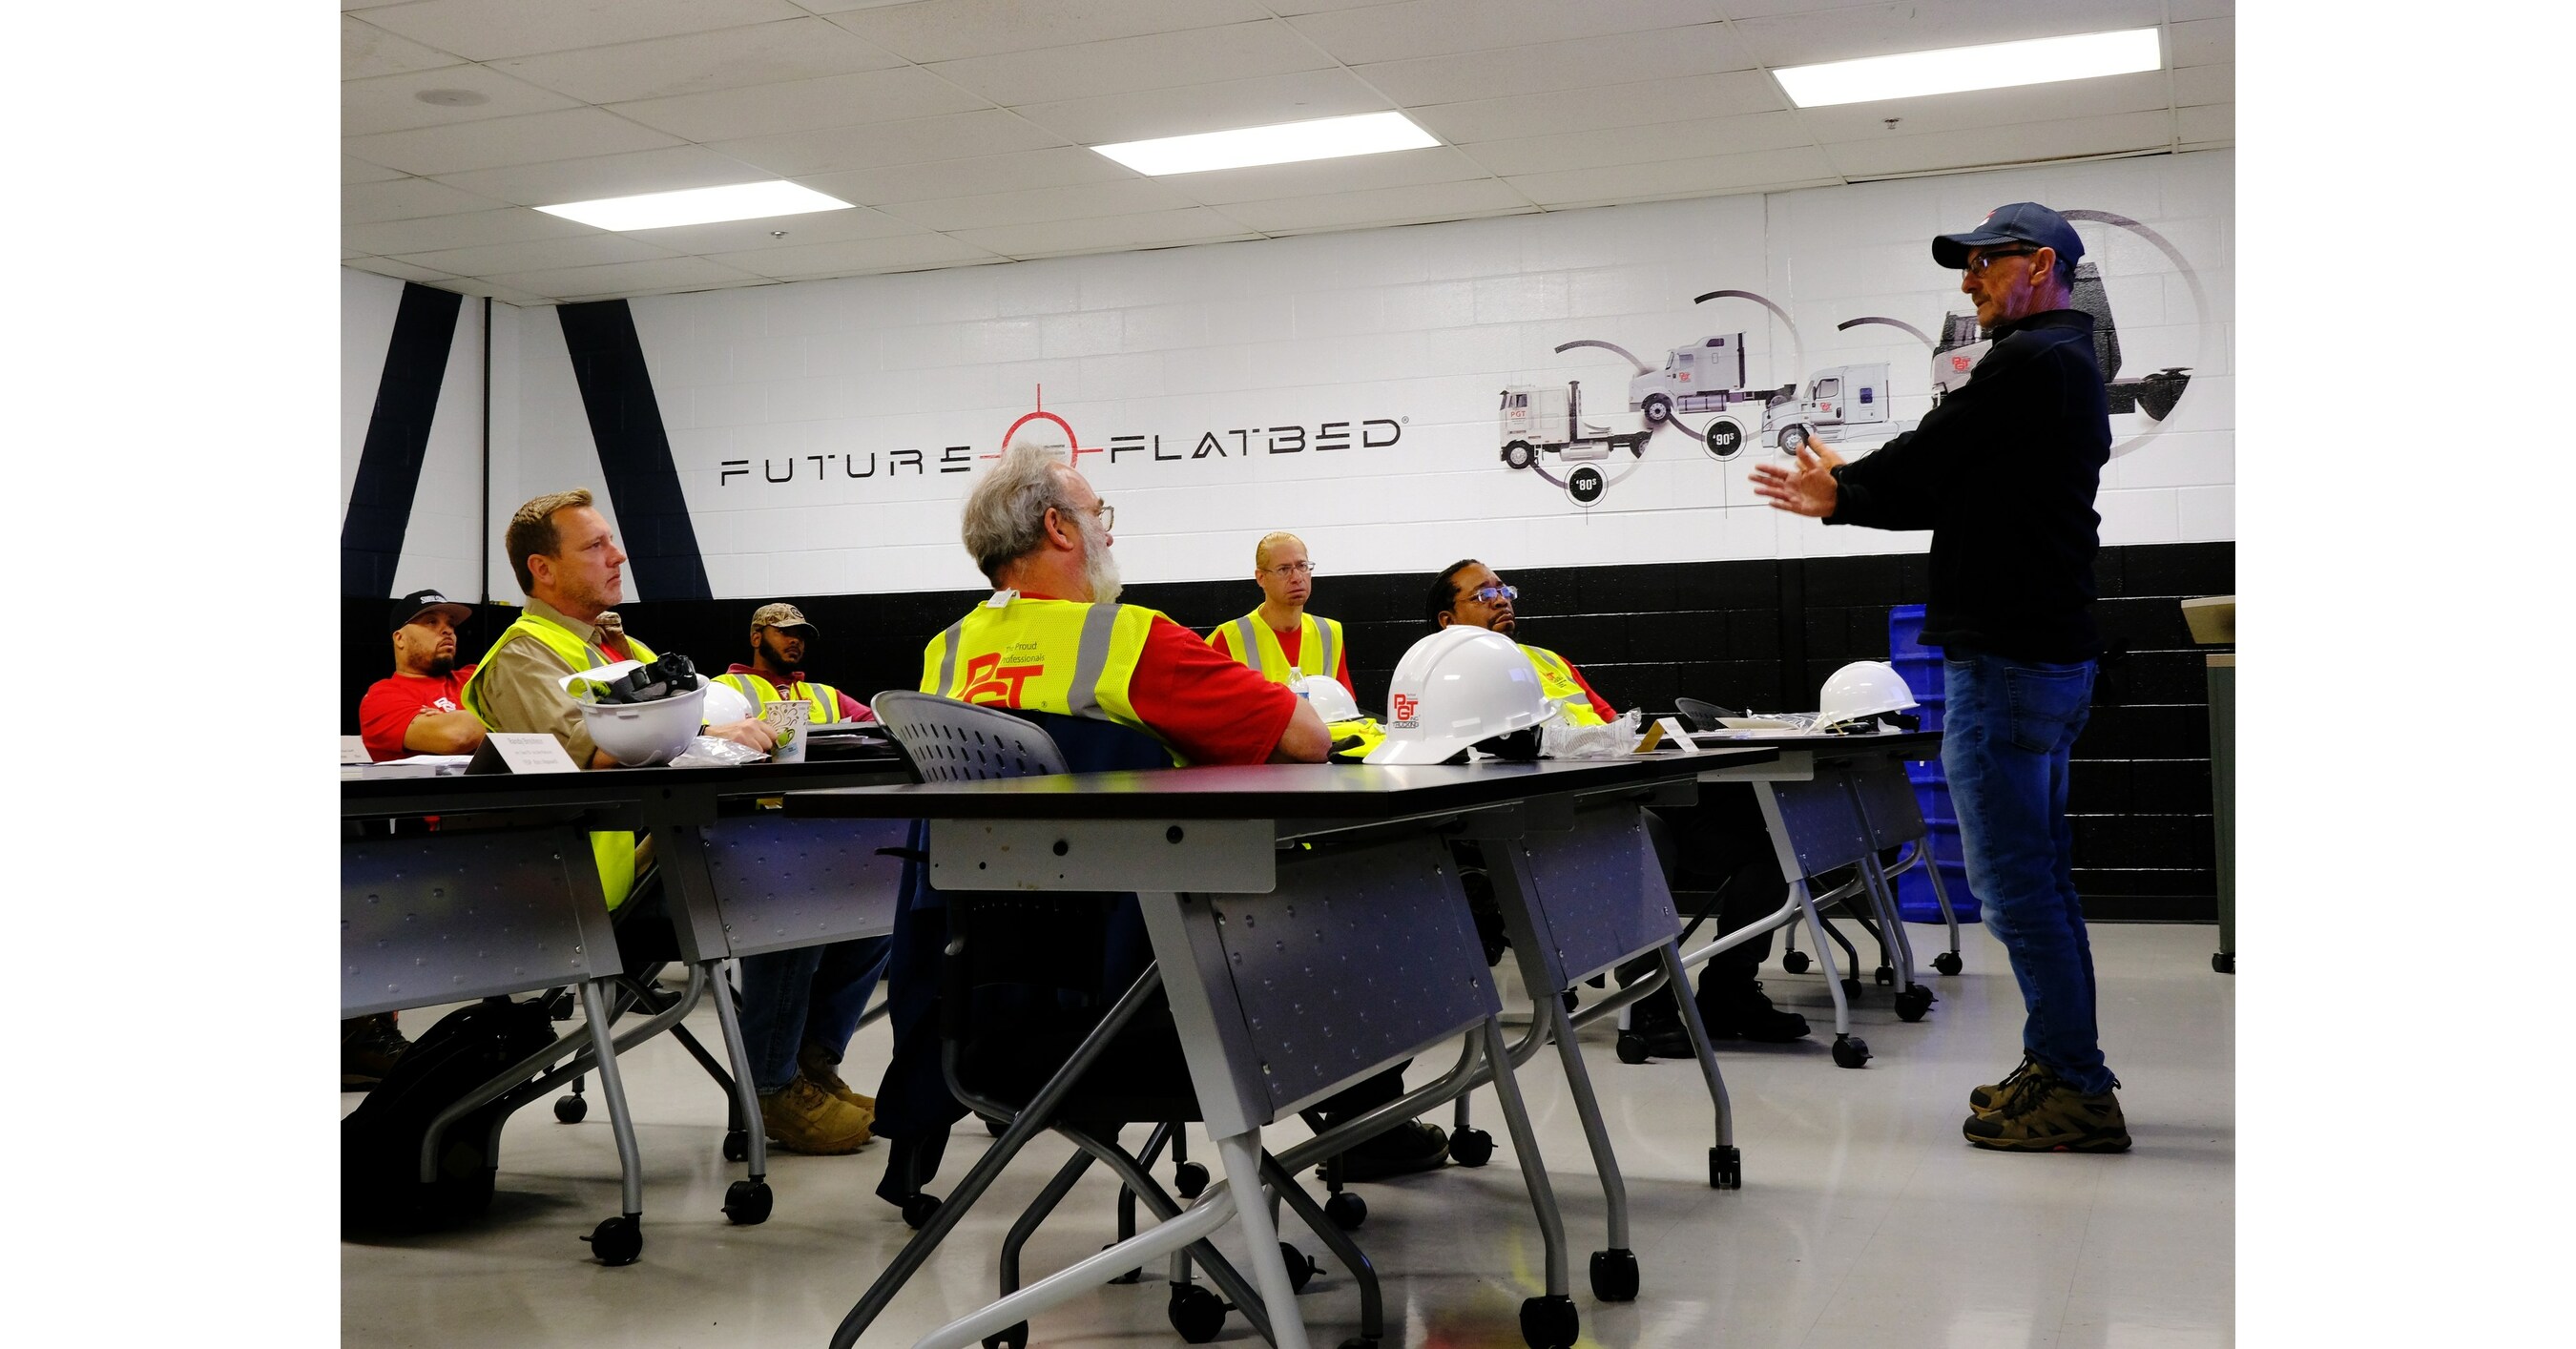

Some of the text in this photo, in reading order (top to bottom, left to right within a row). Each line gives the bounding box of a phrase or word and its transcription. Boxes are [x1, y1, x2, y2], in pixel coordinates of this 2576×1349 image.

[721, 419, 1402, 487] FUTURE FLATBED
[1001, 654, 1046, 665] rofessionals
[1014, 641, 1038, 652] Proud
[955, 652, 1044, 709] PGT
[1394, 694, 1419, 721] PGT
